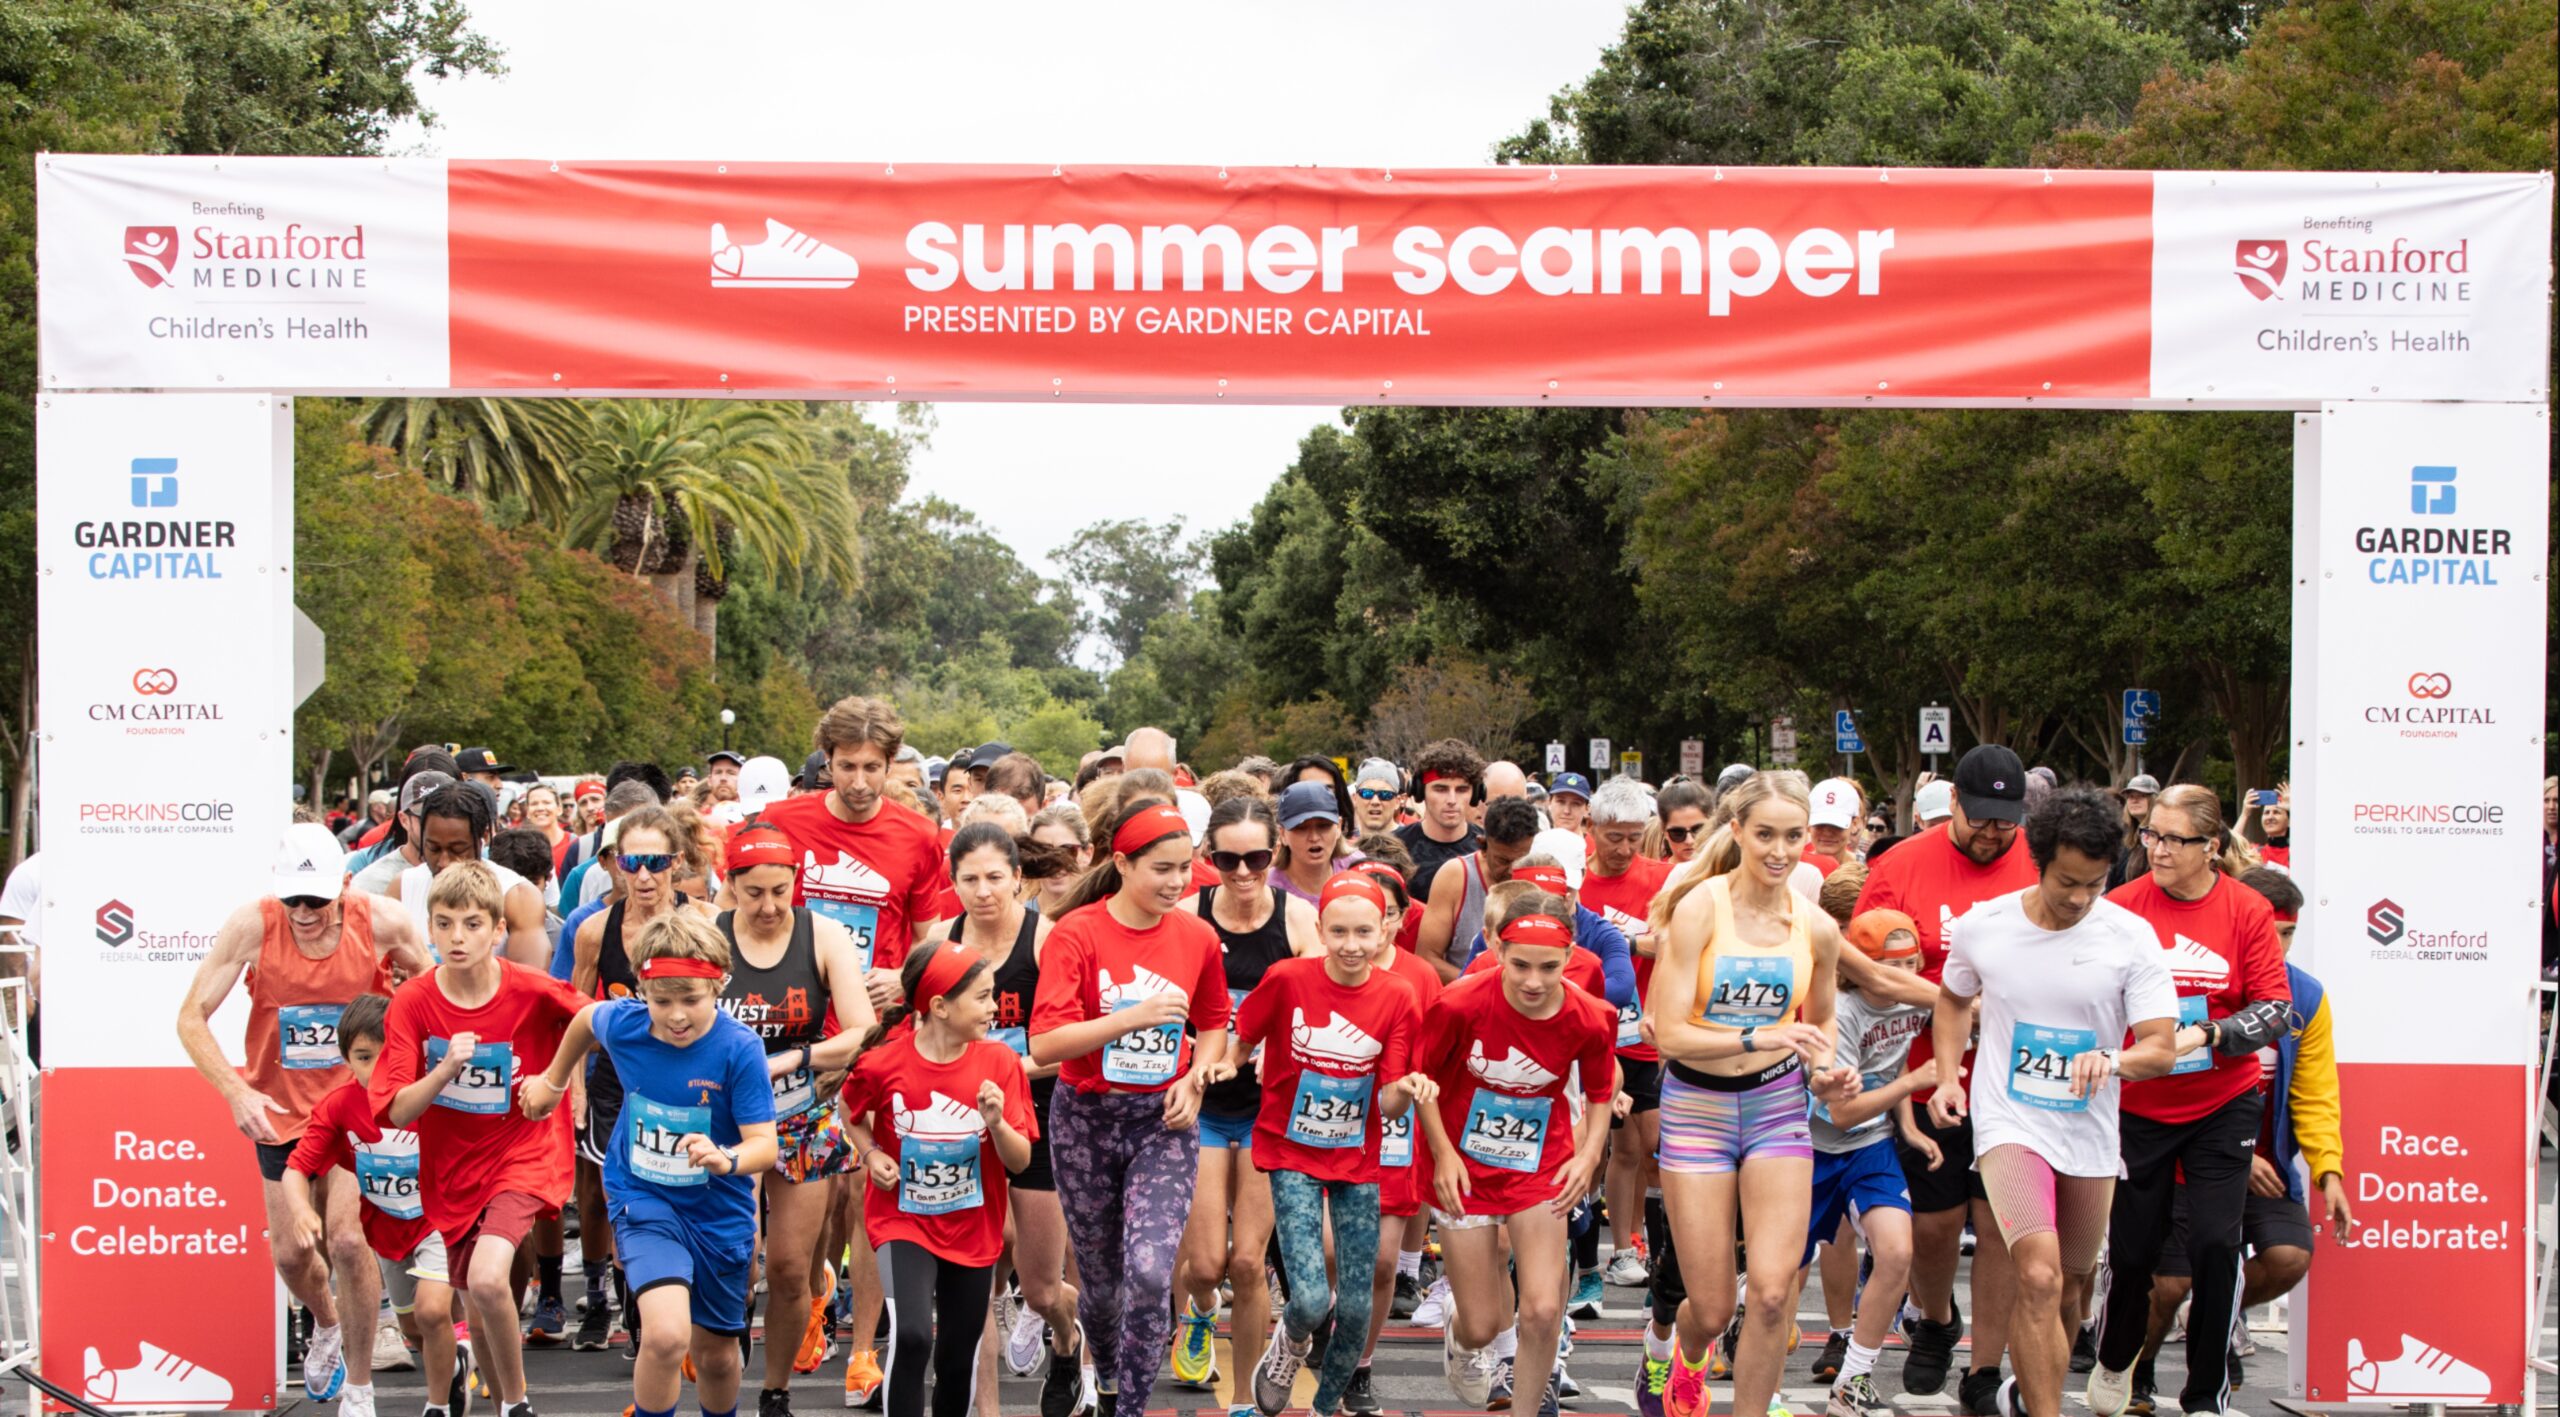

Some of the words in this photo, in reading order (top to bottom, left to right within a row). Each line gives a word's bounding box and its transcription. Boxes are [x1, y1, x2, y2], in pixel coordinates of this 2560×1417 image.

[192, 201, 264, 220] Benefiting
[2303, 216, 2372, 234] Benefiting
[193, 224, 365, 261] Stanford
[2302, 238, 2469, 273] Stanford
[194, 267, 366, 288] MEDICINE
[905, 221, 1358, 293] summer
[1393, 226, 1895, 316] scamper
[2302, 281, 2470, 301] MEDICINE
[148, 316, 274, 339] Children’s
[287, 316, 368, 340] Health
[904, 306, 1076, 333] PRESENTED
[1089, 306, 1124, 333] BY
[1135, 306, 1292, 334] GARDNER
[1304, 307, 1430, 335] CAPITAL
[2257, 329, 2378, 351] Children’s
[2392, 331, 2470, 351] Health
[74, 521, 235, 548] GARDNER
[2356, 527, 2511, 555] GARDNER
[89, 553, 222, 579] CAPITAL
[2369, 558, 2498, 585] CAPITAL
[88, 705, 126, 720] CM
[131, 704, 223, 720] CAPITAL
[2365, 707, 2400, 723] CM
[2406, 707, 2496, 724] CAPITAL
[126, 727, 185, 735] FOUNDATION
[1926, 723, 1943, 742] A
[2400, 730, 2458, 738] FOUNDATION
[1551, 754, 1561, 766] A
[1595, 750, 1605, 762] A
[1826, 792, 1835, 804] S
[81, 826, 125, 834] COUNSEL
[128, 826, 141, 834] TO
[144, 826, 174, 834] GREAT
[177, 826, 234, 834] COMPANIES
[2354, 826, 2397, 834] COUNSEL
[2416, 827, 2446, 835] GREAT
[2448, 827, 2504, 836] COMPANIES
[2407, 930, 2488, 948] Stanford
[100, 952, 145, 961] FEDERAL
[148, 952, 184, 961] CREDIT
[187, 952, 207, 961] UNI
[2371, 950, 2414, 960] FEDERAL
[2417, 951, 2452, 960] CREDIT
[2455, 952, 2488, 961] UNION
[1714, 983, 1789, 1006] 1479
[436, 1060, 506, 1088] 751
[1113, 1057, 1139, 1069] Team
[1761, 1063, 1786, 1082] NIKE
[1786, 1053, 1799, 1069] PR
[1298, 1094, 1364, 1121] 1341
[1296, 1121, 1323, 1136] Team
[1470, 1111, 1542, 1142] 1342
[115, 1131, 205, 1161] Race.
[635, 1121, 704, 1156] 117
[1470, 1140, 1496, 1154] Team
[2380, 1126, 2468, 1156] Race.
[906, 1155, 977, 1188] 1537
[93, 1178, 226, 1208] Donate.
[906, 1188, 936, 1201] Team
[2359, 1172, 2488, 1203] Donate.
[70, 1225, 247, 1256] Celebrate!
[2345, 1219, 2508, 1250] Celebrate!
